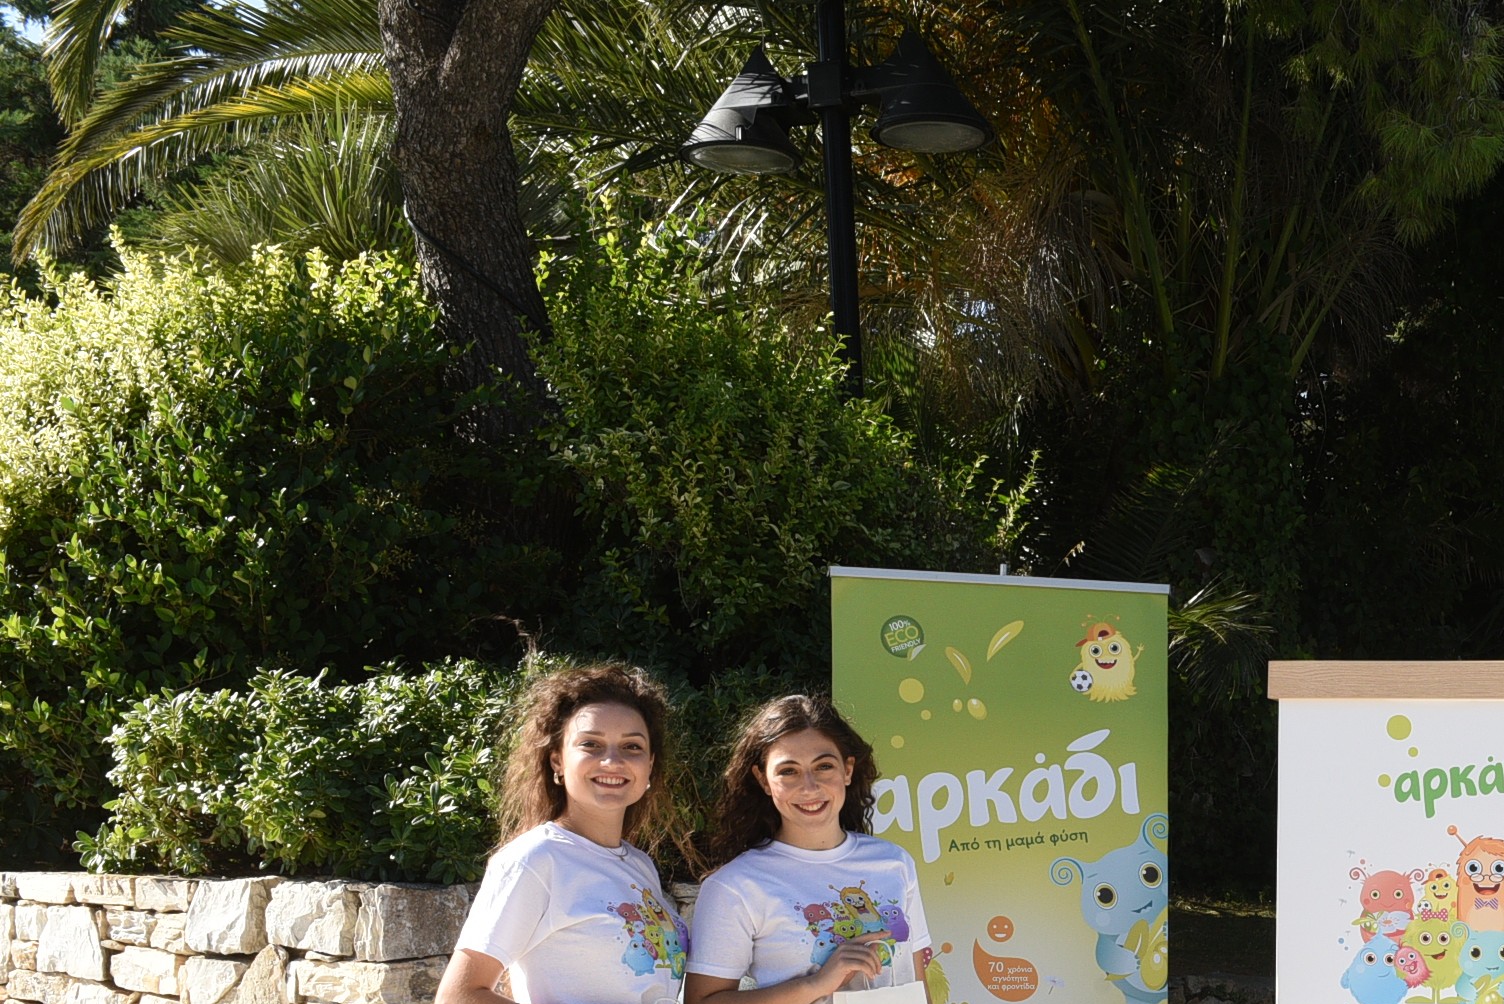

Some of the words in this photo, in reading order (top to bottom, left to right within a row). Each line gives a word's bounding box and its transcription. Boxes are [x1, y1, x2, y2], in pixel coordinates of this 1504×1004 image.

[889, 620, 910, 631] 100%
[884, 625, 919, 646] ECO
[890, 638, 921, 653] FRIENDLY
[873, 729, 1140, 863] αρκάδι
[949, 838, 980, 852] Από
[984, 839, 1001, 851] τη
[1006, 832, 1045, 850] μαμά
[1050, 829, 1088, 846] φύση
[988, 961, 1004, 973] 70
[1007, 965, 1032, 974] χρόνια
[1002, 983, 1035, 991] φροντίδα
